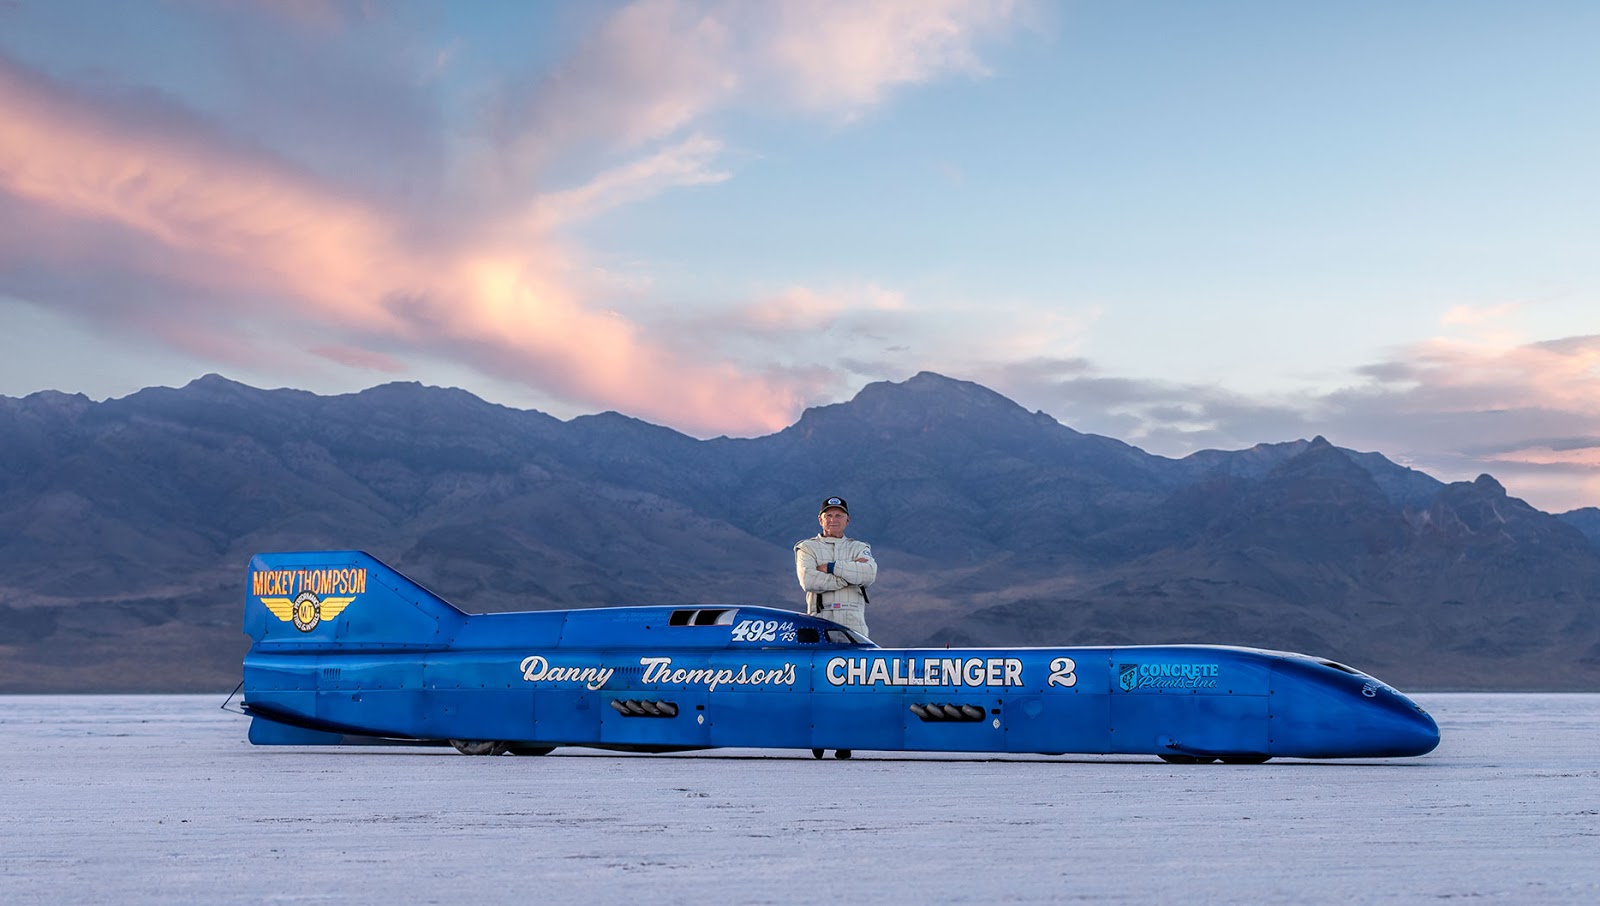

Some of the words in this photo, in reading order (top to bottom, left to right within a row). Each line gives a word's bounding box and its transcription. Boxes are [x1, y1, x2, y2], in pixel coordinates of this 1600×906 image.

[253, 570, 296, 596] MICKEY
[298, 568, 367, 595] THOMPSON
[731, 619, 779, 642] 492
[519, 655, 614, 691] Danny
[640, 657, 797, 692] Thompson's
[826, 657, 1024, 687] CHALLENGER
[1048, 657, 1078, 687] 2
[1139, 663, 1219, 680] CONCRETE
